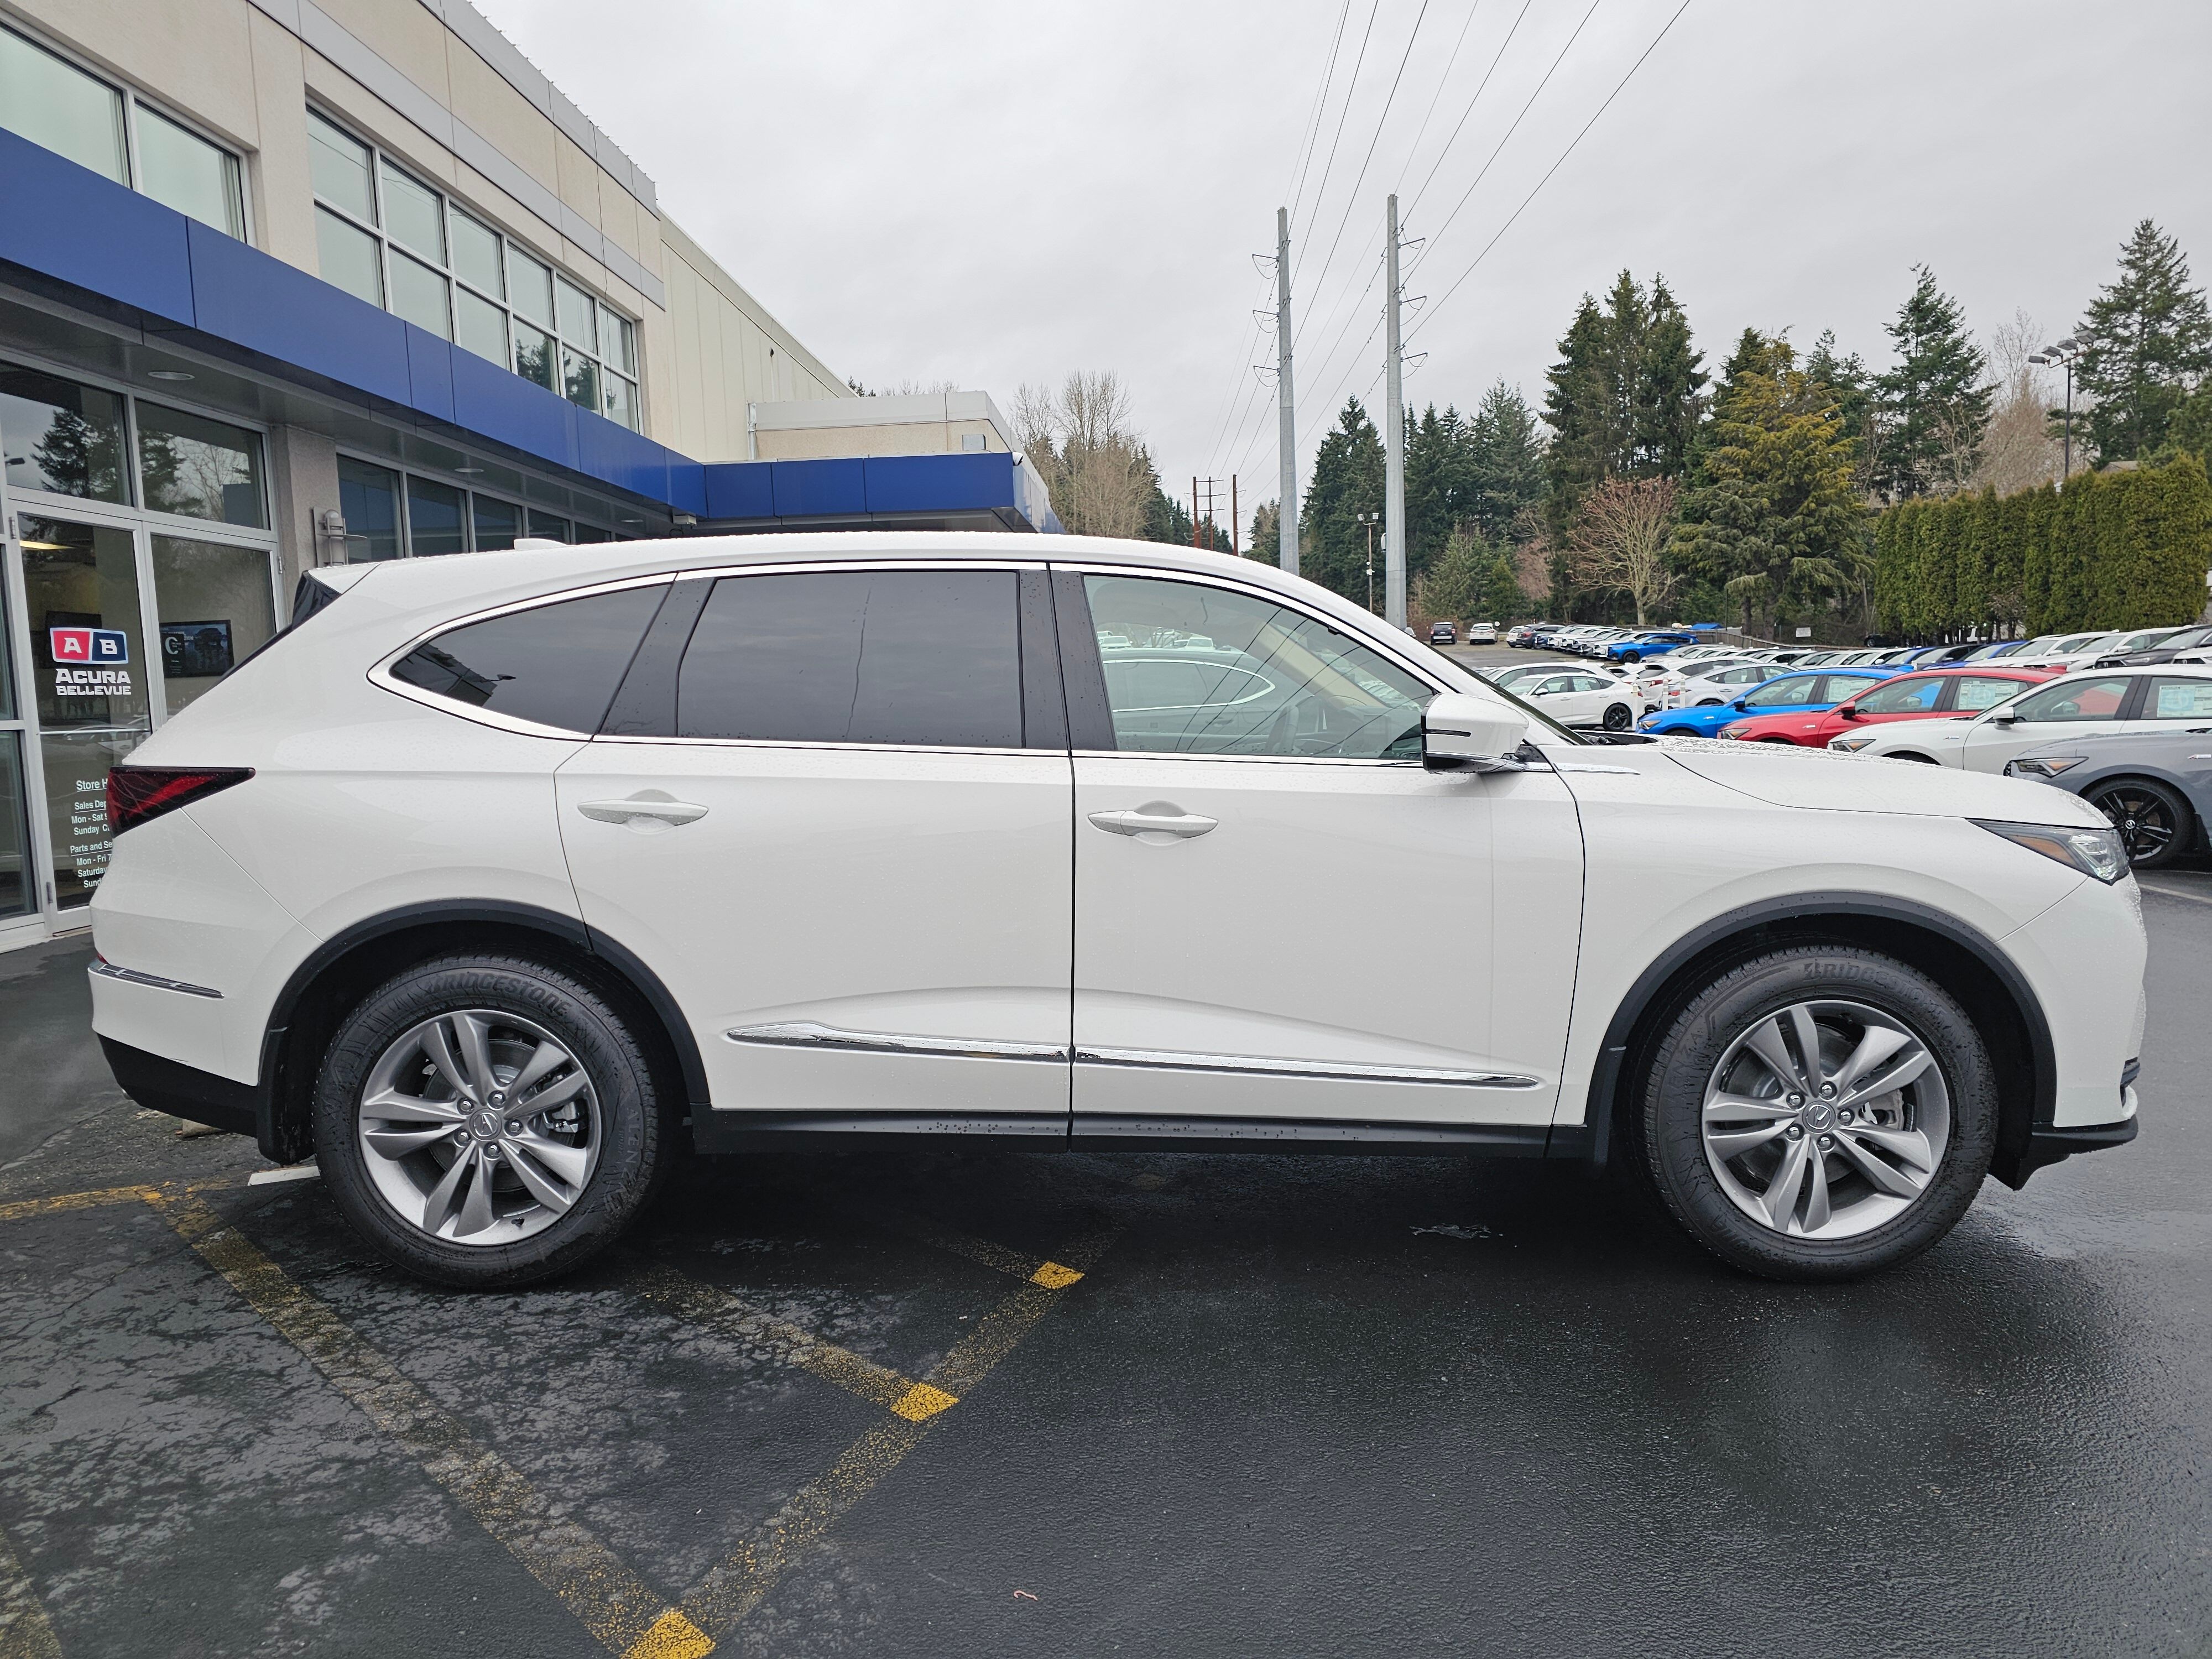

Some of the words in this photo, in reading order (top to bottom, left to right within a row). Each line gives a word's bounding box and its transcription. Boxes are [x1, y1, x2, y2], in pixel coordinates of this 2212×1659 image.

[64, 638, 82, 653] A
[98, 639, 117, 654] B
[55, 668, 131, 684] ACURA
[56, 686, 131, 695] BELLEVUE
[76, 780, 100, 790] Store
[75, 801, 93, 810] Sales
[95, 800, 107, 809] Dep
[74, 826, 99, 835] Sunday
[70, 844, 88, 853] Parts
[90, 842, 102, 851] and
[76, 858, 92, 866] Mon
[97, 854, 106, 863] Fri
[84, 878, 102, 888] Sund
